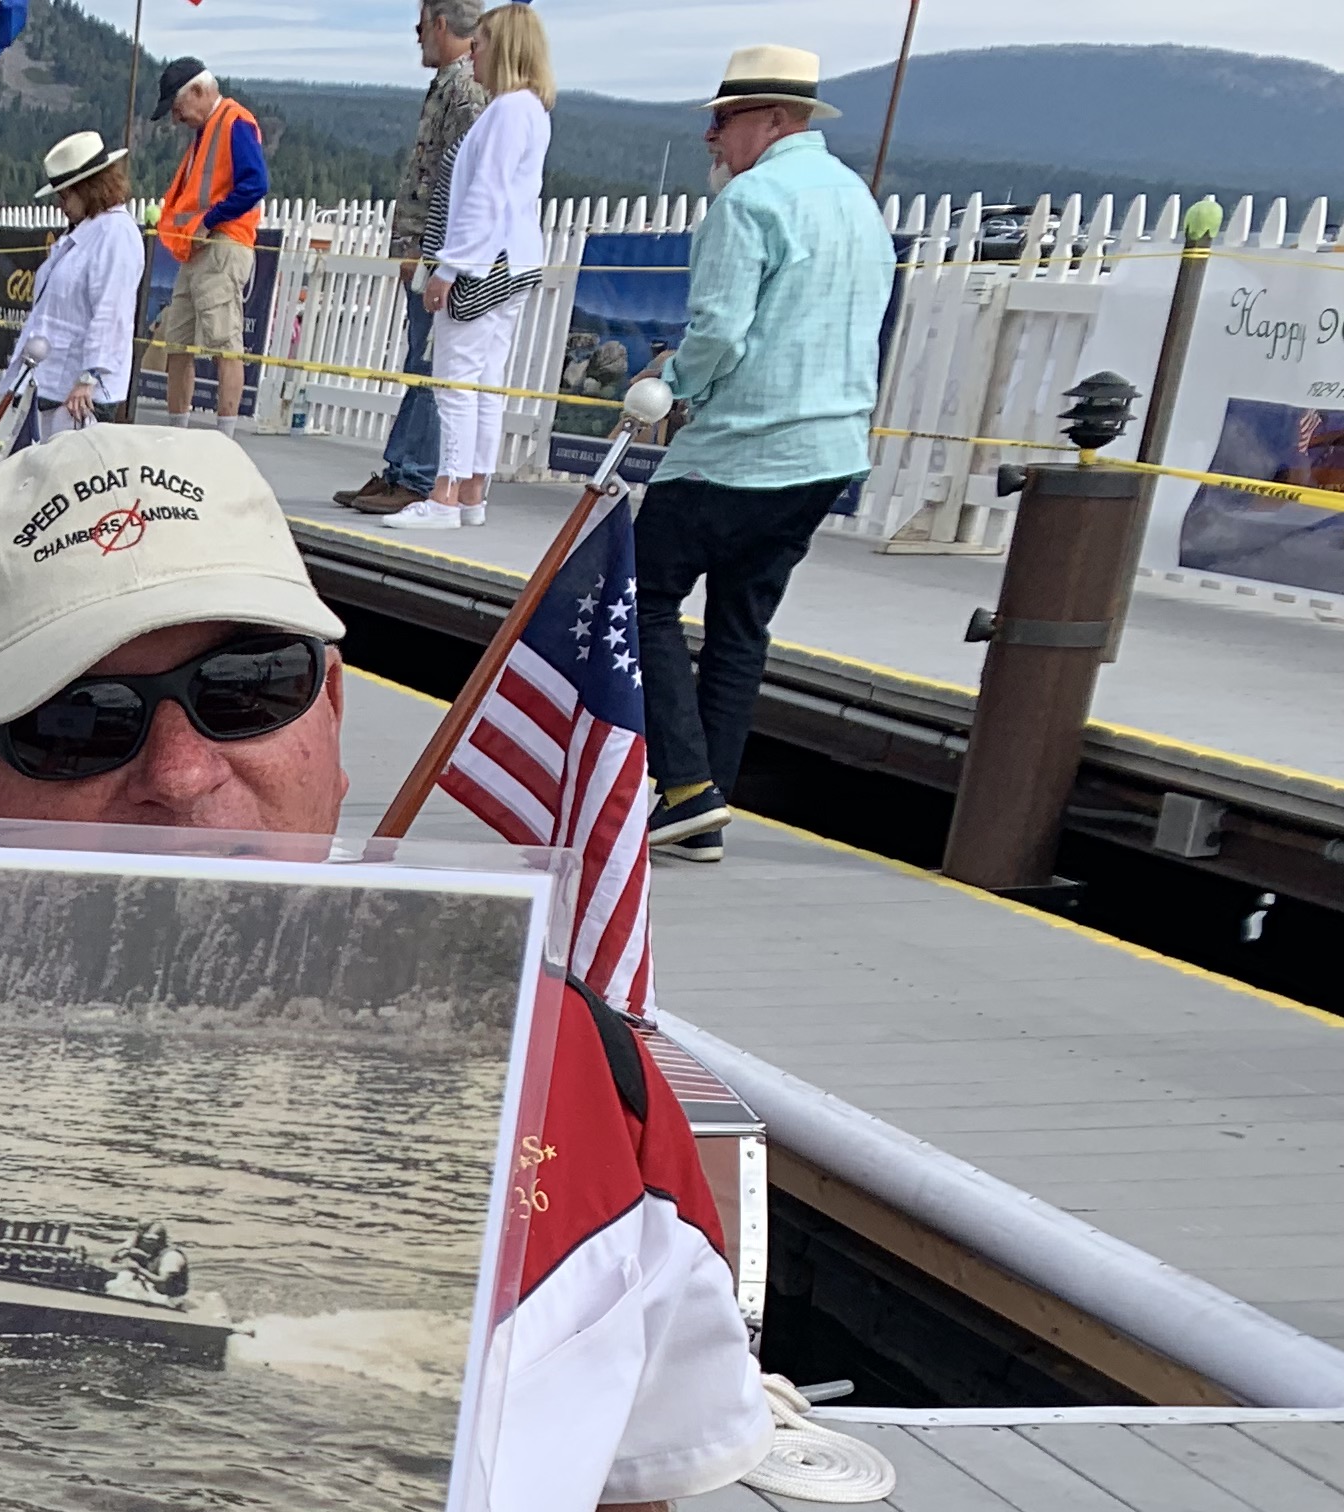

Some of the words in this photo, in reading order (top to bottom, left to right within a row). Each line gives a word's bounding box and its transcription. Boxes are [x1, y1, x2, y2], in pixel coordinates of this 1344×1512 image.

[1226, 287, 1307, 364] Happy
[1317, 308, 1344, 345] 9
[13, 494, 70, 548] SPEED
[74, 467, 130, 502] BOAT
[140, 465, 205, 502] RACES
[33, 518, 123, 563] CHAMBERS
[129, 506, 200, 527] LANDING
